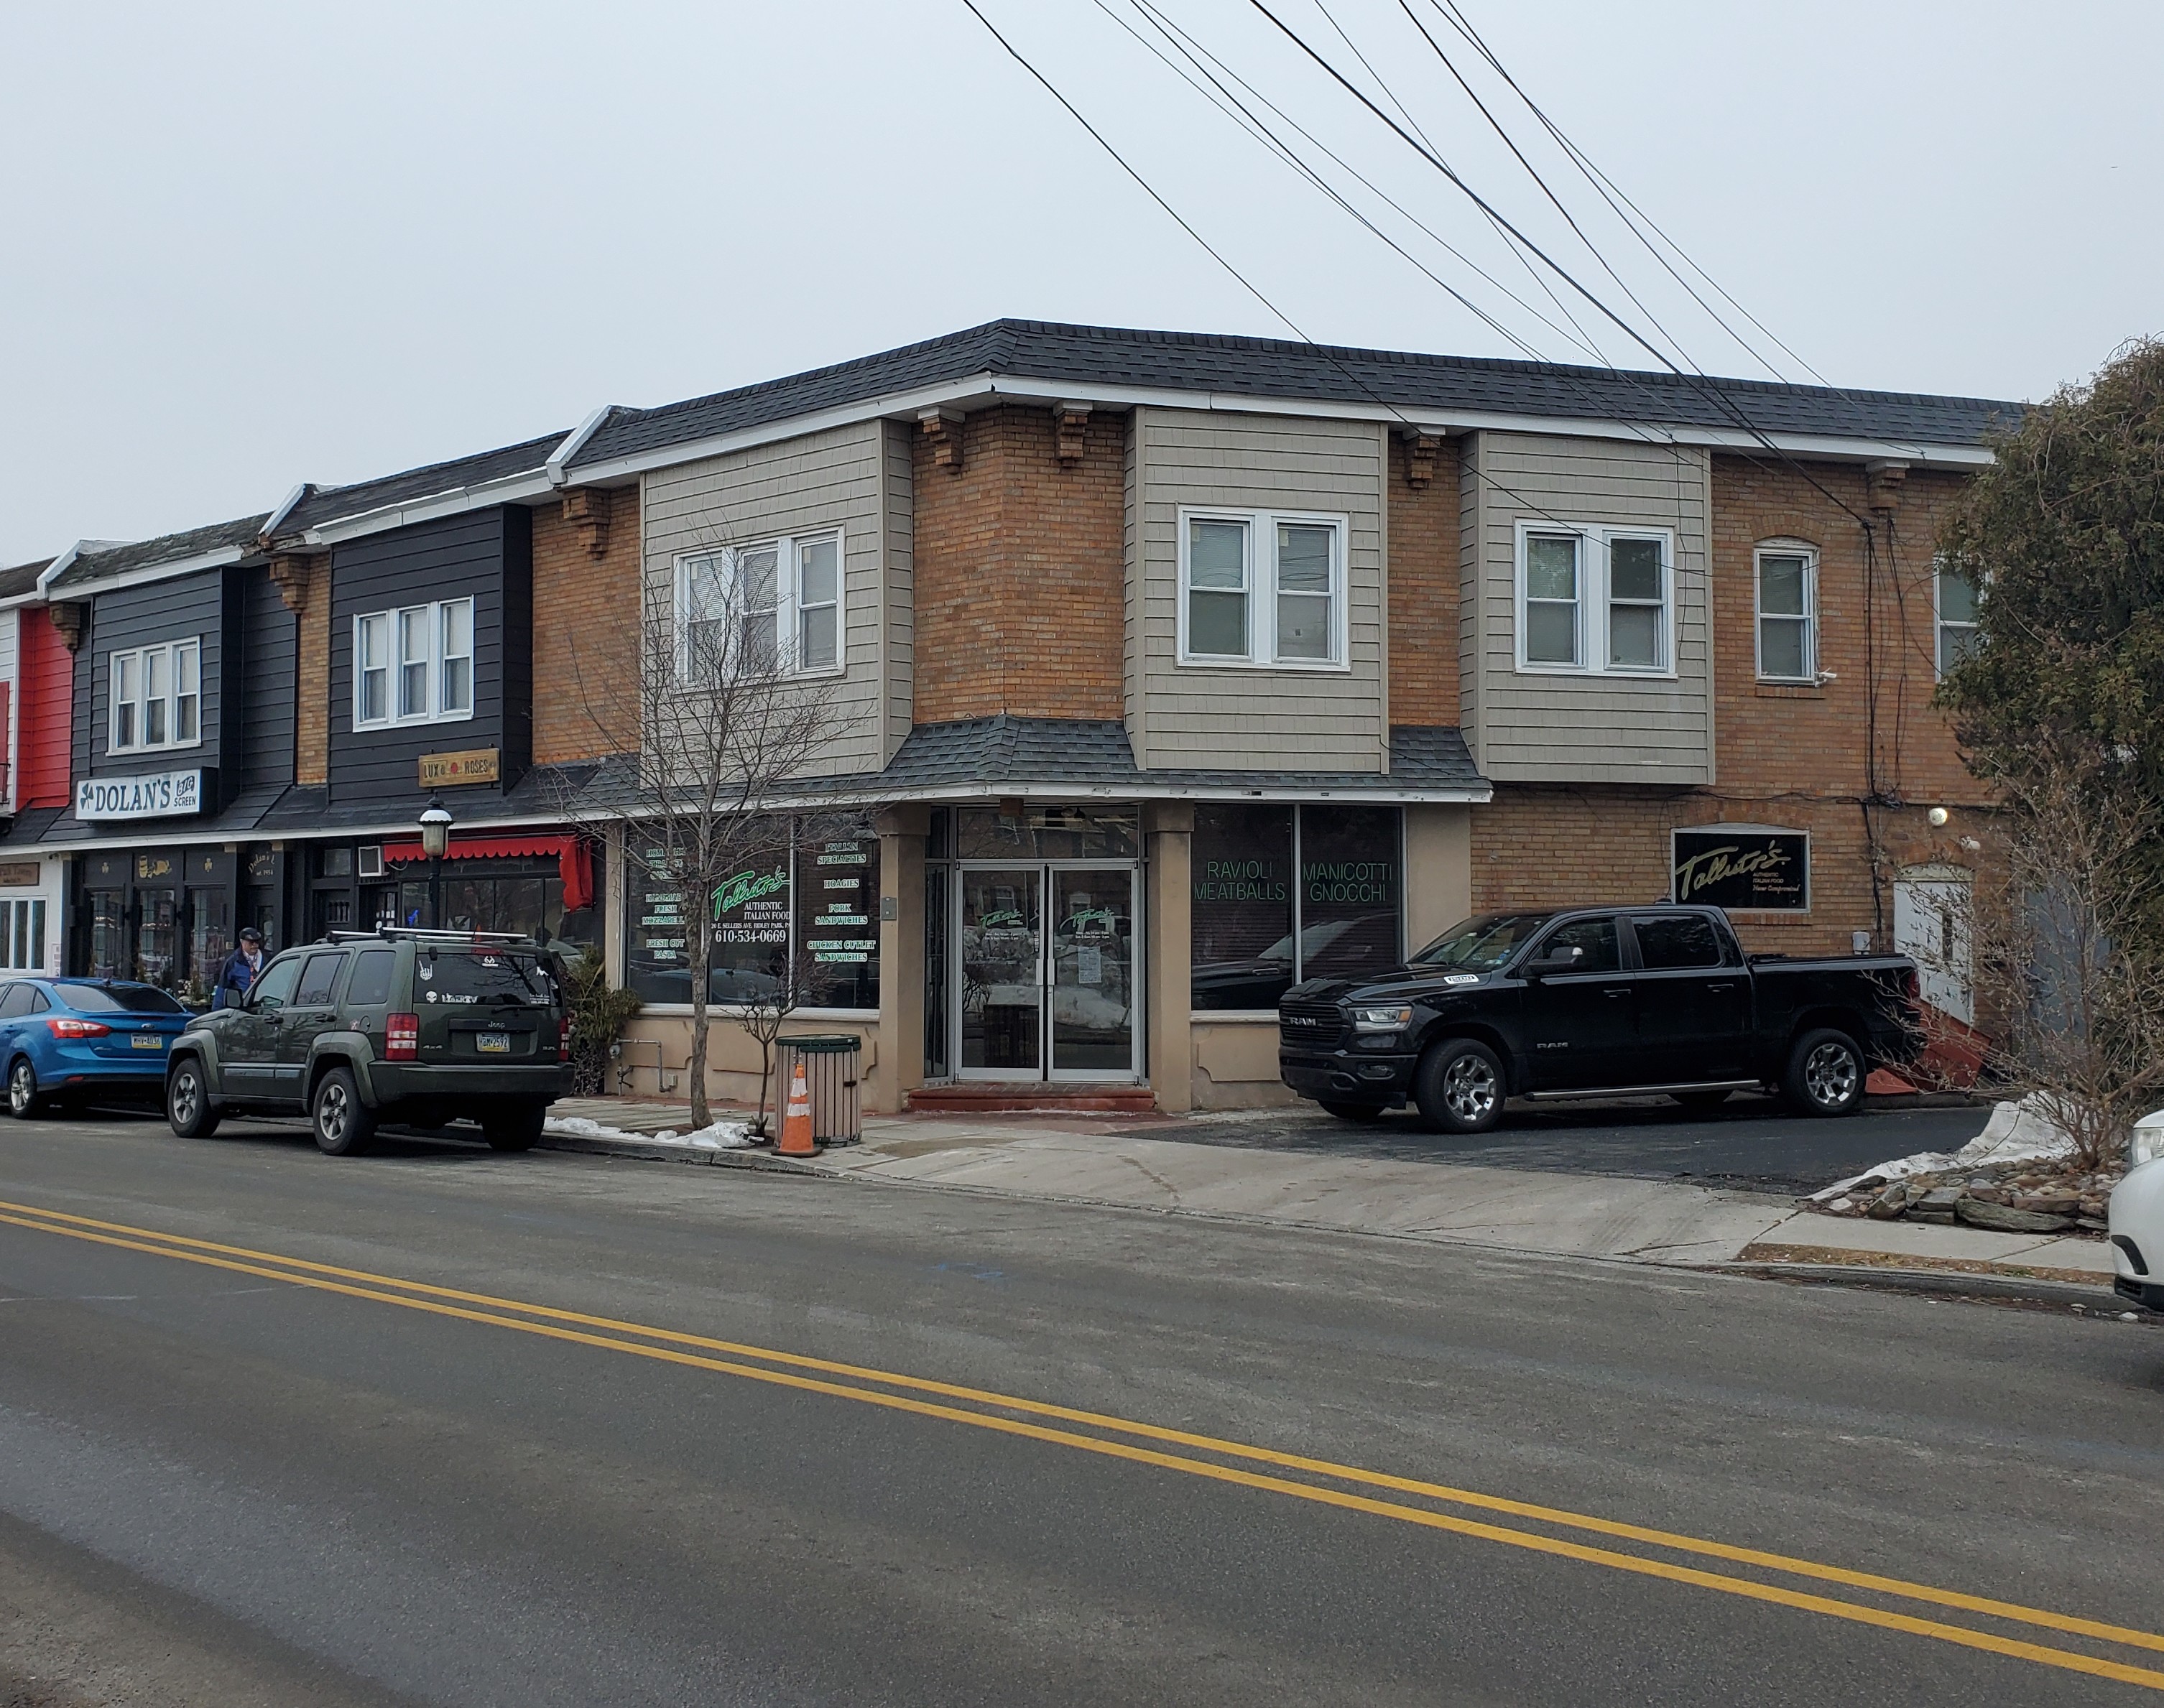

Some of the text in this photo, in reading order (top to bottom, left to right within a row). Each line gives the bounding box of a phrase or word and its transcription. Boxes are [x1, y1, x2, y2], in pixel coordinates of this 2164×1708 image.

[424, 764, 438, 778] LUX
[464, 758, 488, 774] ROSES
[177, 776, 195, 795] BIG
[95, 778, 171, 812] DOLAN'S
[173, 795, 196, 807] SCREEN
[826, 841, 859, 852] ITALIAN
[817, 854, 866, 865] SPECIALTIES
[1207, 860, 1272, 879] RAVIOLI
[1303, 863, 1392, 881] MANICOTTI
[1675, 840, 1791, 901] Talluto's
[823, 878, 859, 888] HOAGIES
[711, 865, 790, 921] Talluto's
[1194, 882, 1285, 901] MEATBALLS
[1310, 883, 1386, 902] GNOCCHI
[645, 893, 682, 902] HANDMAD
[654, 904, 678, 914] FRESH
[744, 901, 783, 910] AUTHENTIC
[828, 904, 852, 913] PORK
[642, 916, 685, 925] MOZZARELL
[744, 911, 791, 920] ITALIAN FOOD
[815, 915, 868, 925] SANDWICHES
[715, 929, 786, 942] 610-534-0669
[646, 939, 685, 947] FRESH CUT
[807, 940, 876, 950] CHICKEN CUTLET
[654, 950, 677, 959] PASTA
[814, 952, 867, 962] SANDWICHES
[488, 1021, 505, 1029] Jeep
[1288, 1016, 1316, 1026] RAM
